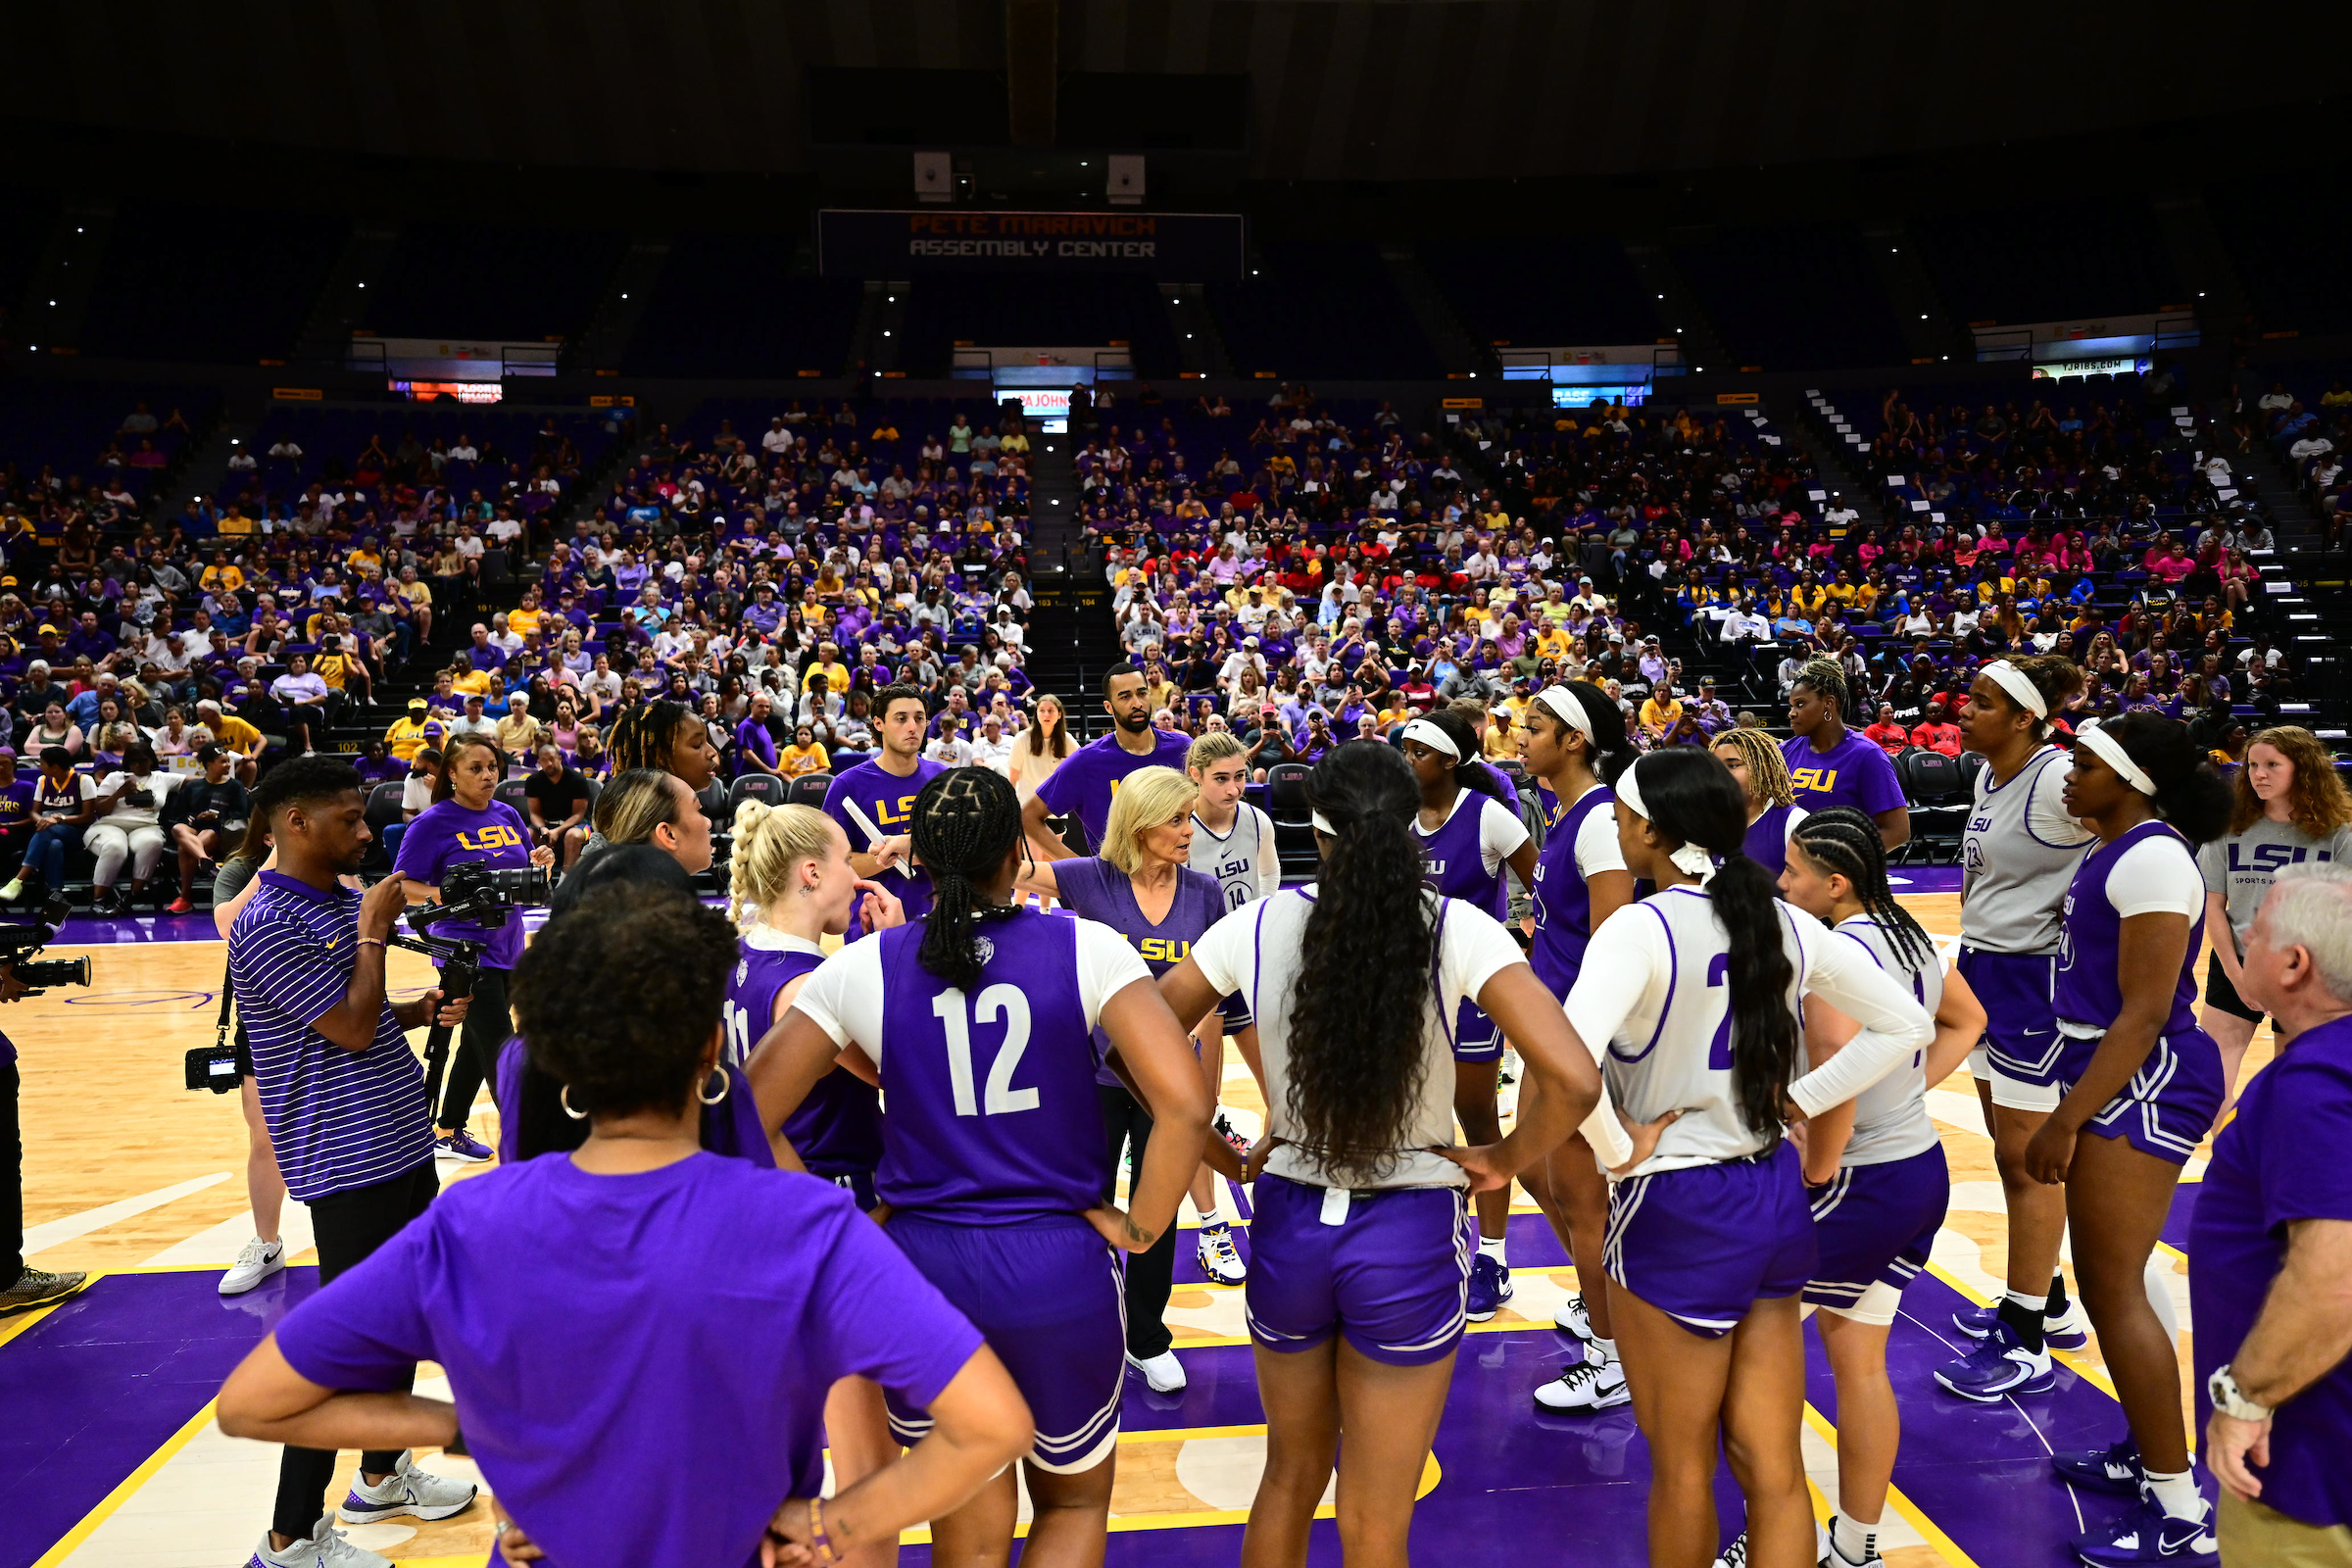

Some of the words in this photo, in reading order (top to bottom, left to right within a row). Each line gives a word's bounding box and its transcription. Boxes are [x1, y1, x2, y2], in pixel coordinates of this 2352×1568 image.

[909, 215, 989, 235] PETE
[999, 216, 1156, 236] MARAVICH
[909, 239, 1050, 257] ASSEMBLY
[1058, 241, 1156, 258] CENTER
[2062, 360, 2122, 369] TJRIBS.COM
[1754, 717, 1768, 729] 05
[337, 741, 359, 753] 102
[745, 782, 768, 791] LSU
[804, 781, 827, 791] LSU
[1282, 772, 1303, 781] LSU
[1791, 766, 1838, 793] SU
[43, 795, 76, 808] LSU
[875, 795, 916, 825] LS
[1966, 815, 1992, 832] LSU
[456, 825, 521, 851] LSU
[1967, 847, 1984, 869] 23
[1214, 858, 1250, 880] LSU
[2234, 877, 2266, 886] SPORTS
[450, 903, 470, 914] RONIN
[1229, 887, 1247, 911] 14
[1120, 933, 1191, 963] SU
[1706, 953, 1736, 1070] 2
[723, 998, 750, 1069] 11
[933, 982, 1041, 1117] 12
